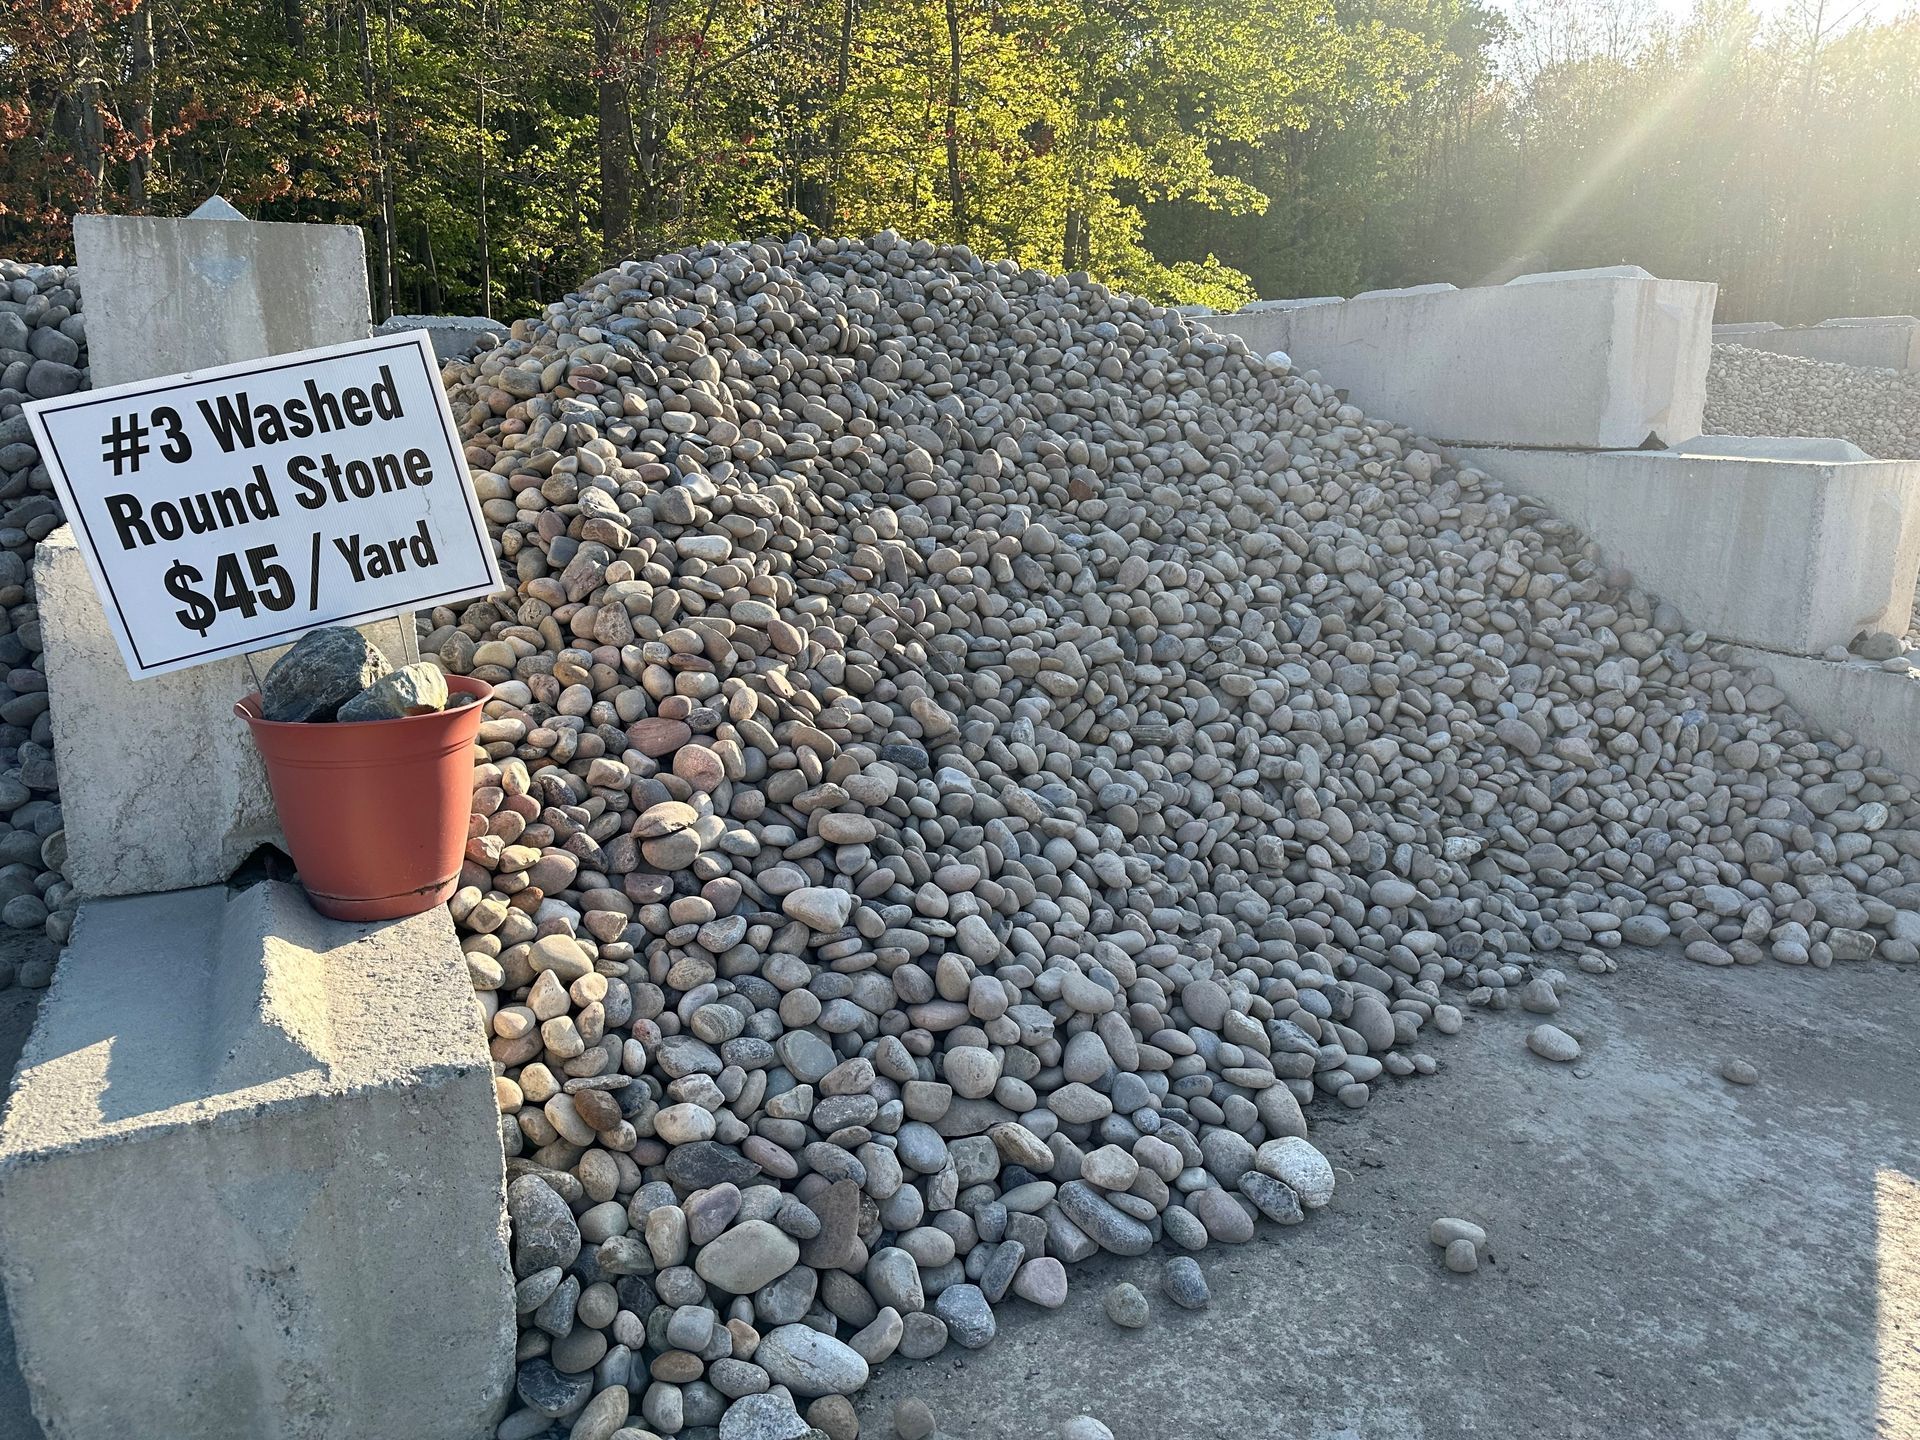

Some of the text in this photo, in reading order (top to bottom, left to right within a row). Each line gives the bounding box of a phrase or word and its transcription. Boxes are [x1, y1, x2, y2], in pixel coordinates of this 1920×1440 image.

[102, 365, 404, 477] #3 Washed
[104, 446, 434, 550] Round Stone
[164, 544, 296, 637] $45
[333, 519, 439, 582] Yard
